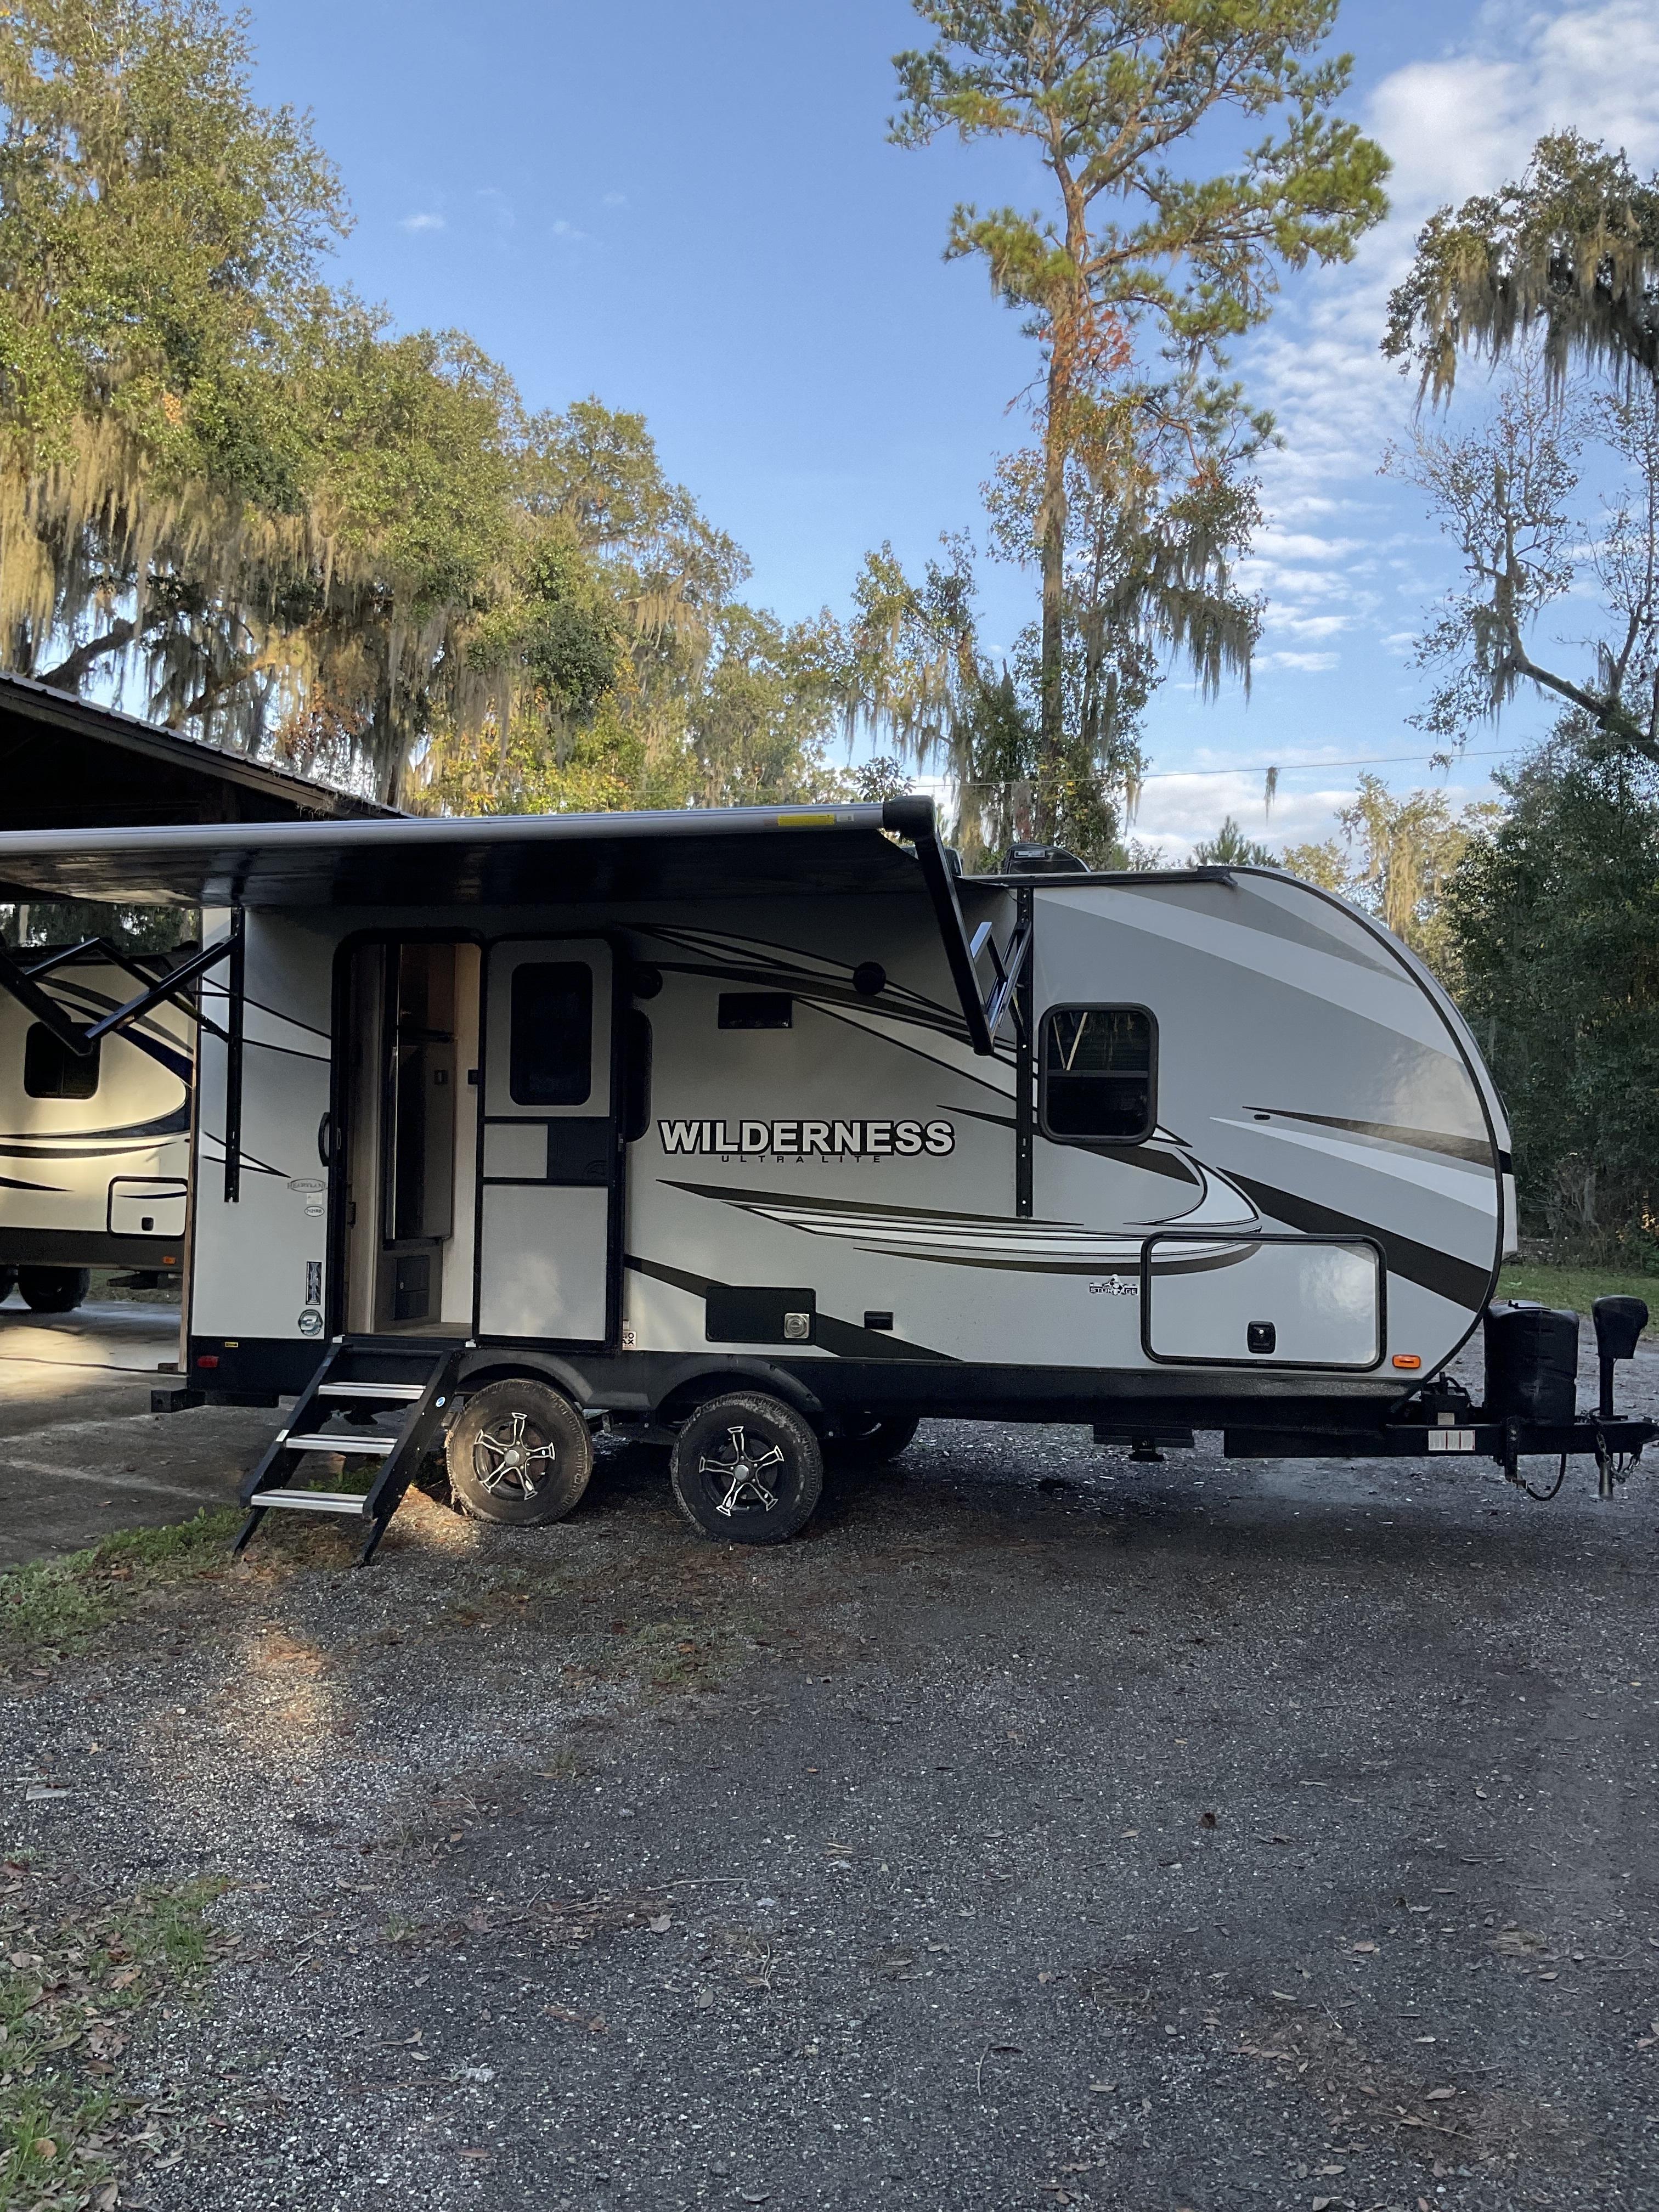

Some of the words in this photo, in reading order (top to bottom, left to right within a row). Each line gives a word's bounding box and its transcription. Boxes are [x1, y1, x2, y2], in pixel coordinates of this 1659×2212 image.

[658, 1120, 955, 1156] WILDERNESS
[721, 1155, 805, 1164] ULTRA
[821, 1155, 881, 1163] LITE
